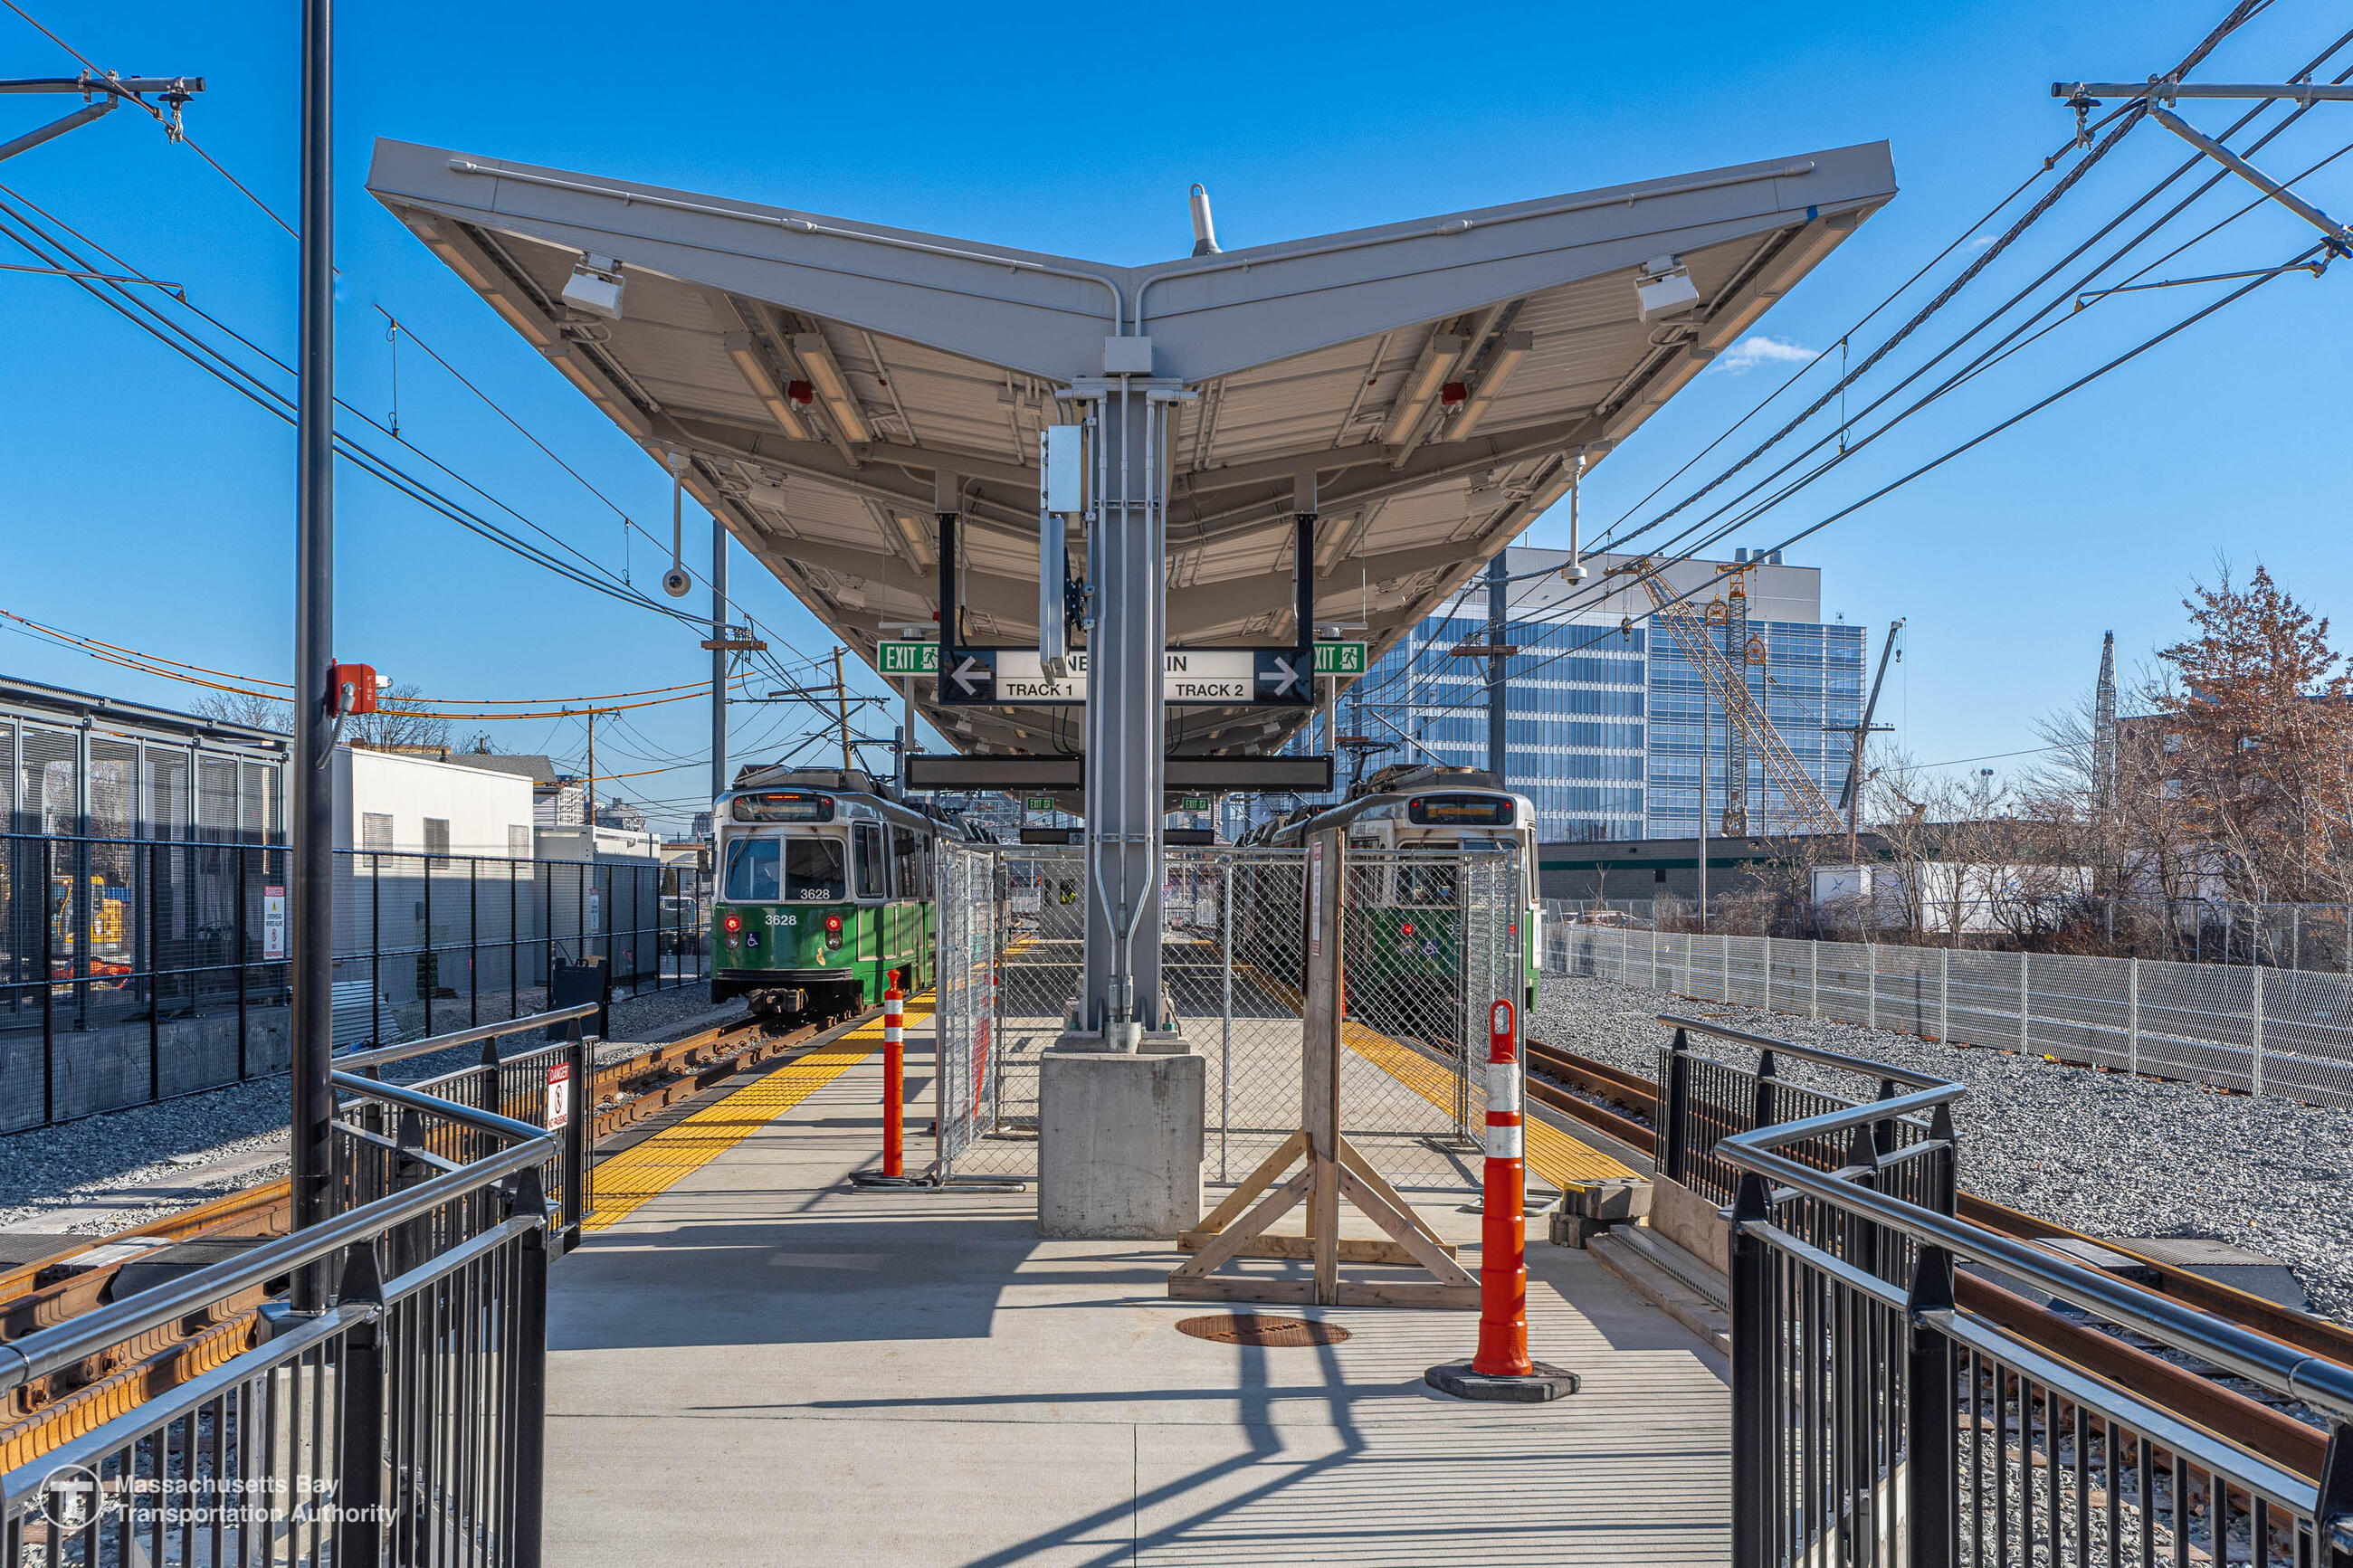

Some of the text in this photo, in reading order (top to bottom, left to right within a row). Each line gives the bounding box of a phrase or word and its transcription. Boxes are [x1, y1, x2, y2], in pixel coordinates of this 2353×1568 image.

[886, 646, 917, 670] EXIT
[1314, 646, 1336, 670] XIT
[1006, 683, 1072, 697] TRACK 1
[1176, 683, 1243, 697] TRACK 2
[800, 889, 830, 900] 3628
[765, 914, 797, 926] 3628
[549, 1065, 570, 1082] DANGER
